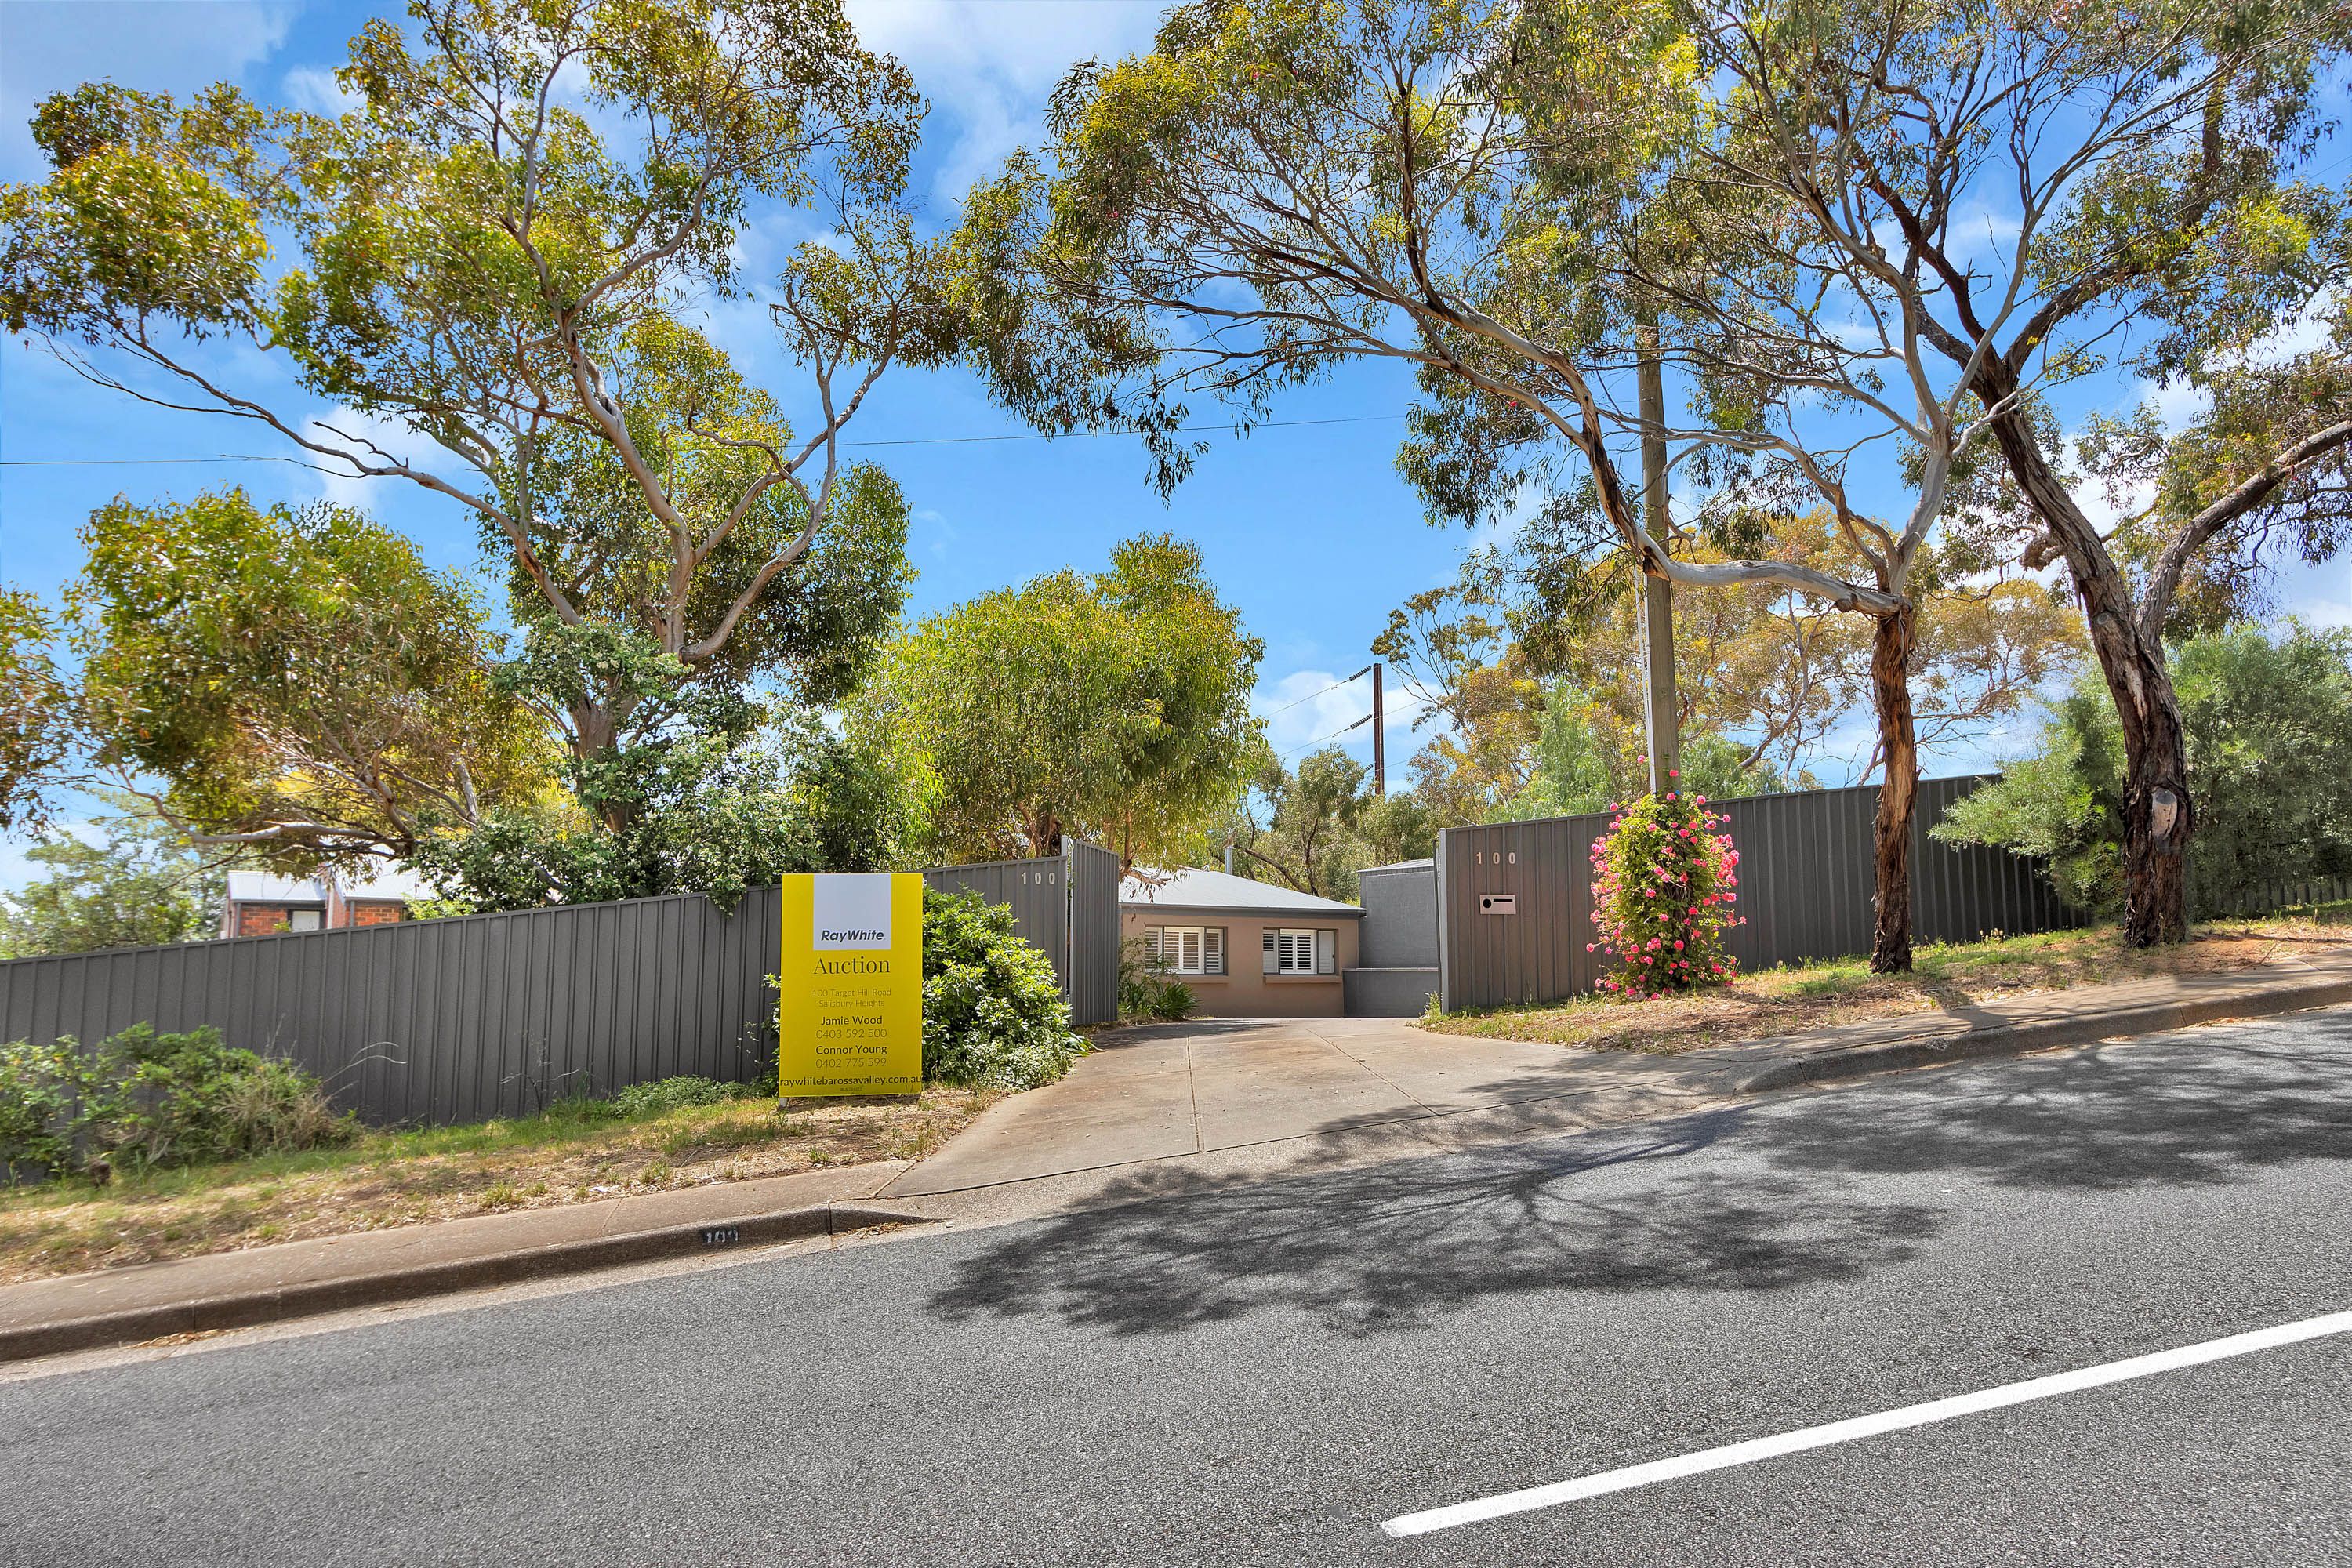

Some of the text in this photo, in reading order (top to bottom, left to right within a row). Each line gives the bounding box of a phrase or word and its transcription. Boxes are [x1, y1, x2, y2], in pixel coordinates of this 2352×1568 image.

[1476, 851, 1516, 865] 100
[1022, 872, 1055, 885] 100
[814, 956, 891, 975] Auction
[830, 989, 855, 998] Target
[857, 988, 870, 996] Hill
[872, 988, 891, 996] Road
[818, 999, 885, 1008] Salisbury Heights
[821, 1014, 883, 1025] Jamie Wood
[815, 1028, 887, 1039] 0403 592 500
[815, 1044, 887, 1055] Connor Young
[815, 1057, 887, 1069] 0402 775 599
[780, 1074, 921, 1088] raywhitebarossavalley.com.au
